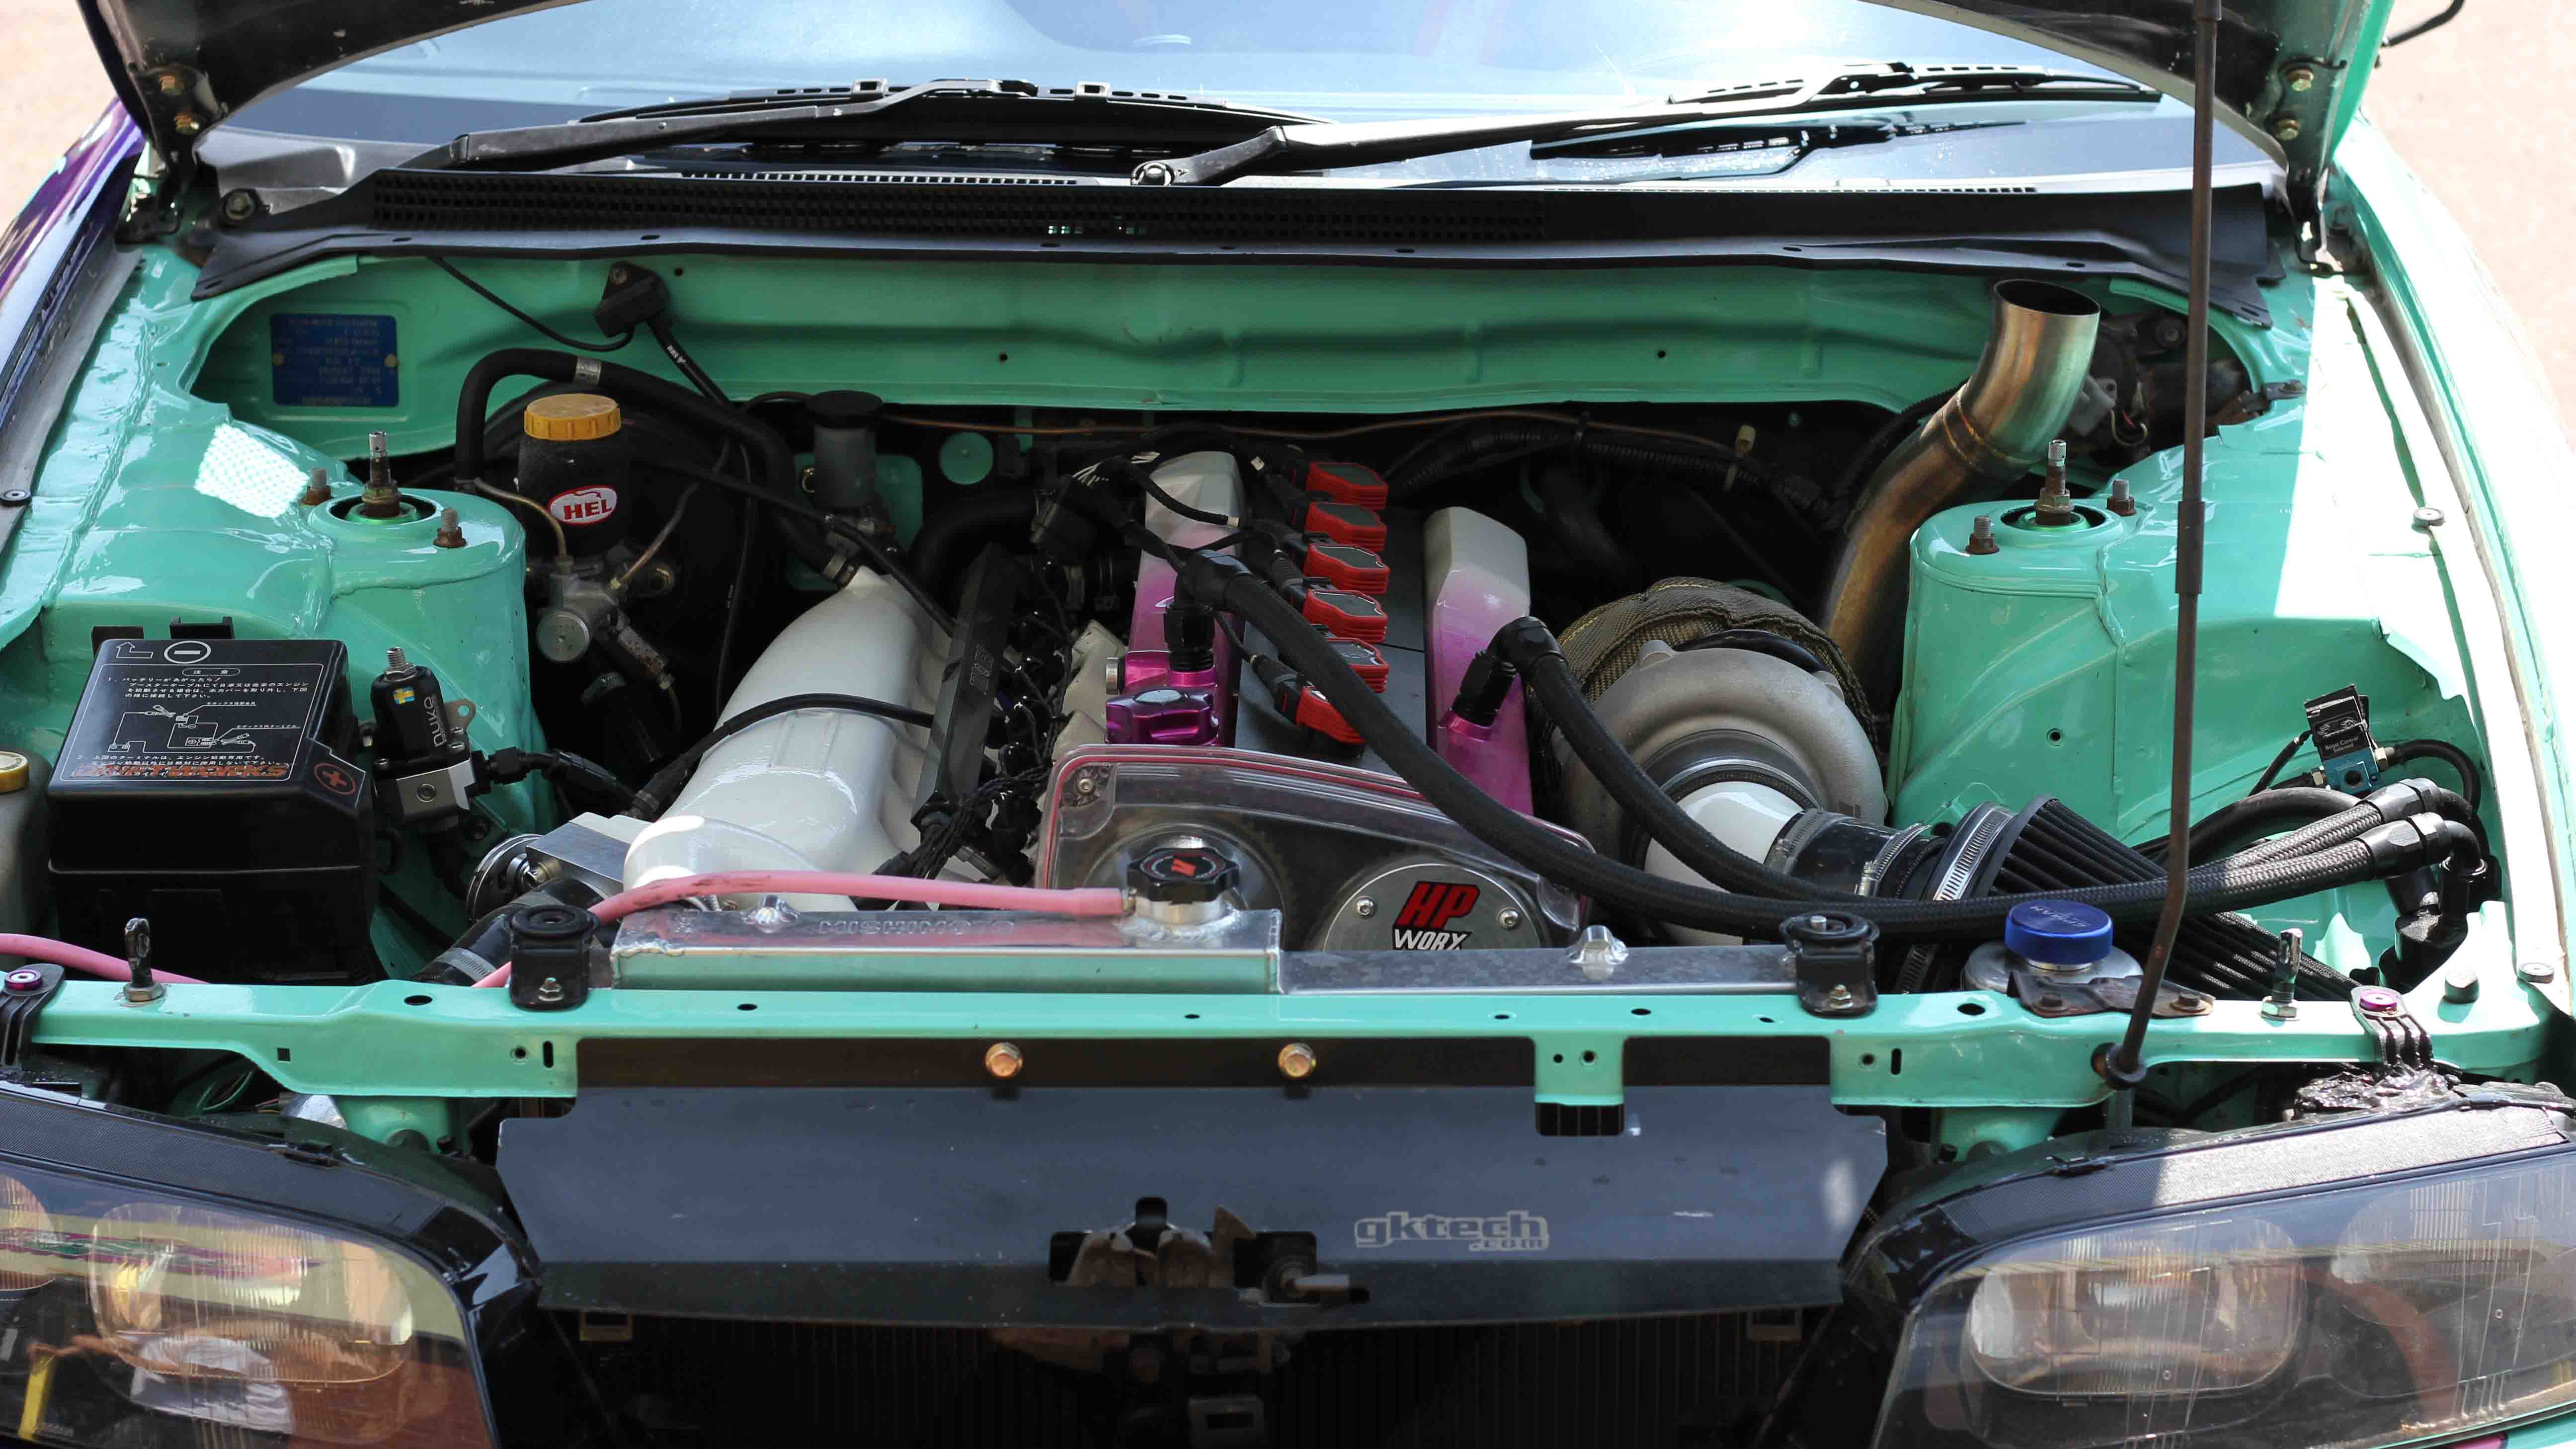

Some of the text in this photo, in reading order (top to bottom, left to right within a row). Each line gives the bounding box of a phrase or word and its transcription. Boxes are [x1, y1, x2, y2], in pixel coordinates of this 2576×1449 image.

[563, 498, 613, 520] HEL
[424, 696, 446, 747] nuke
[2340, 736, 2359, 745] Control
[1395, 882, 1480, 930] HP
[1393, 928, 1468, 951] WORX
[1356, 1210, 1549, 1249] gktech
